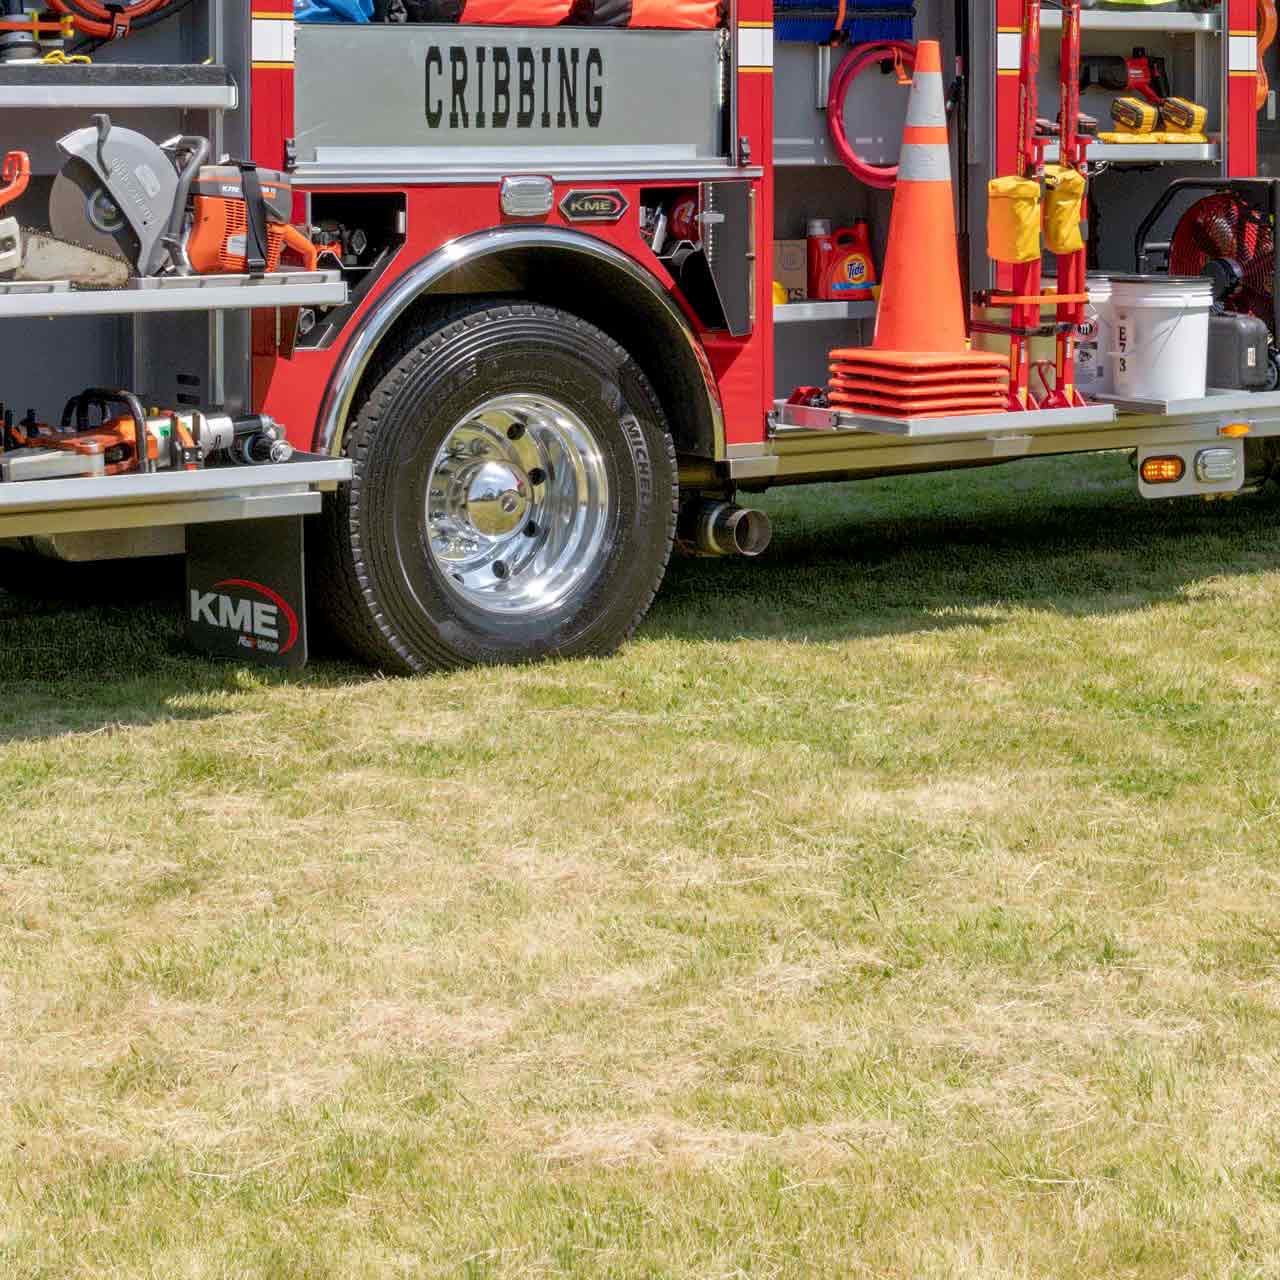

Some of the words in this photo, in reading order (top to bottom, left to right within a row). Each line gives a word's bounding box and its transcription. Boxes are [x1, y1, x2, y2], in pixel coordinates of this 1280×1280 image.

[425, 46, 603, 128] CRIBBING
[571, 200, 612, 212] KME
[847, 262, 865, 279] Tide
[190, 589, 279, 639] KME
